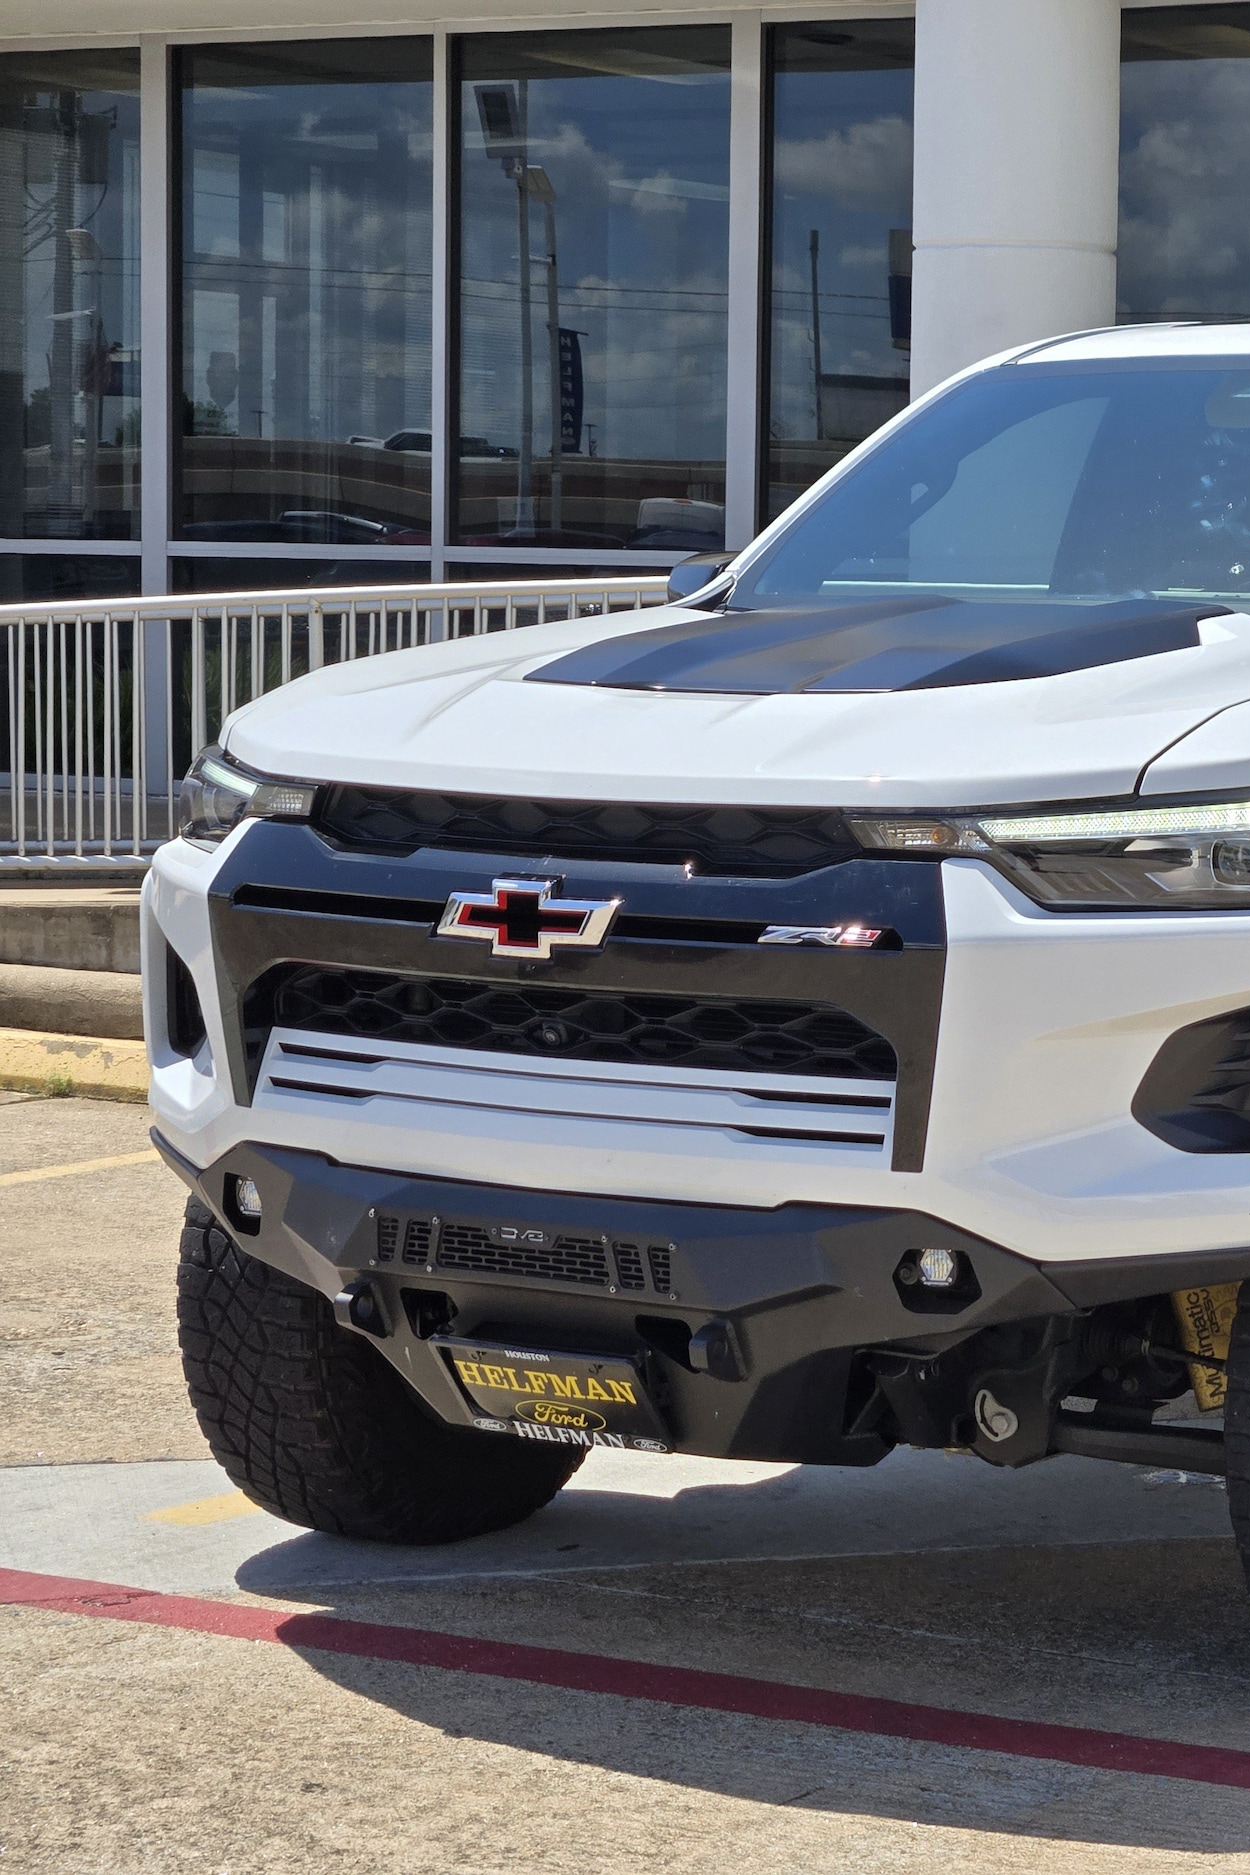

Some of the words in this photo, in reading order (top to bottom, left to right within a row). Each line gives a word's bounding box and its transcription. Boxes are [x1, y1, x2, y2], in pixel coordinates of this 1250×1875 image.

[757, 925, 881, 947] ZR2
[504, 1350, 550, 1363] HOUSTON
[454, 1360, 638, 1405] HELFMAN
[533, 1402, 589, 1428] Ford
[512, 1420, 626, 1449] HELFMAN
